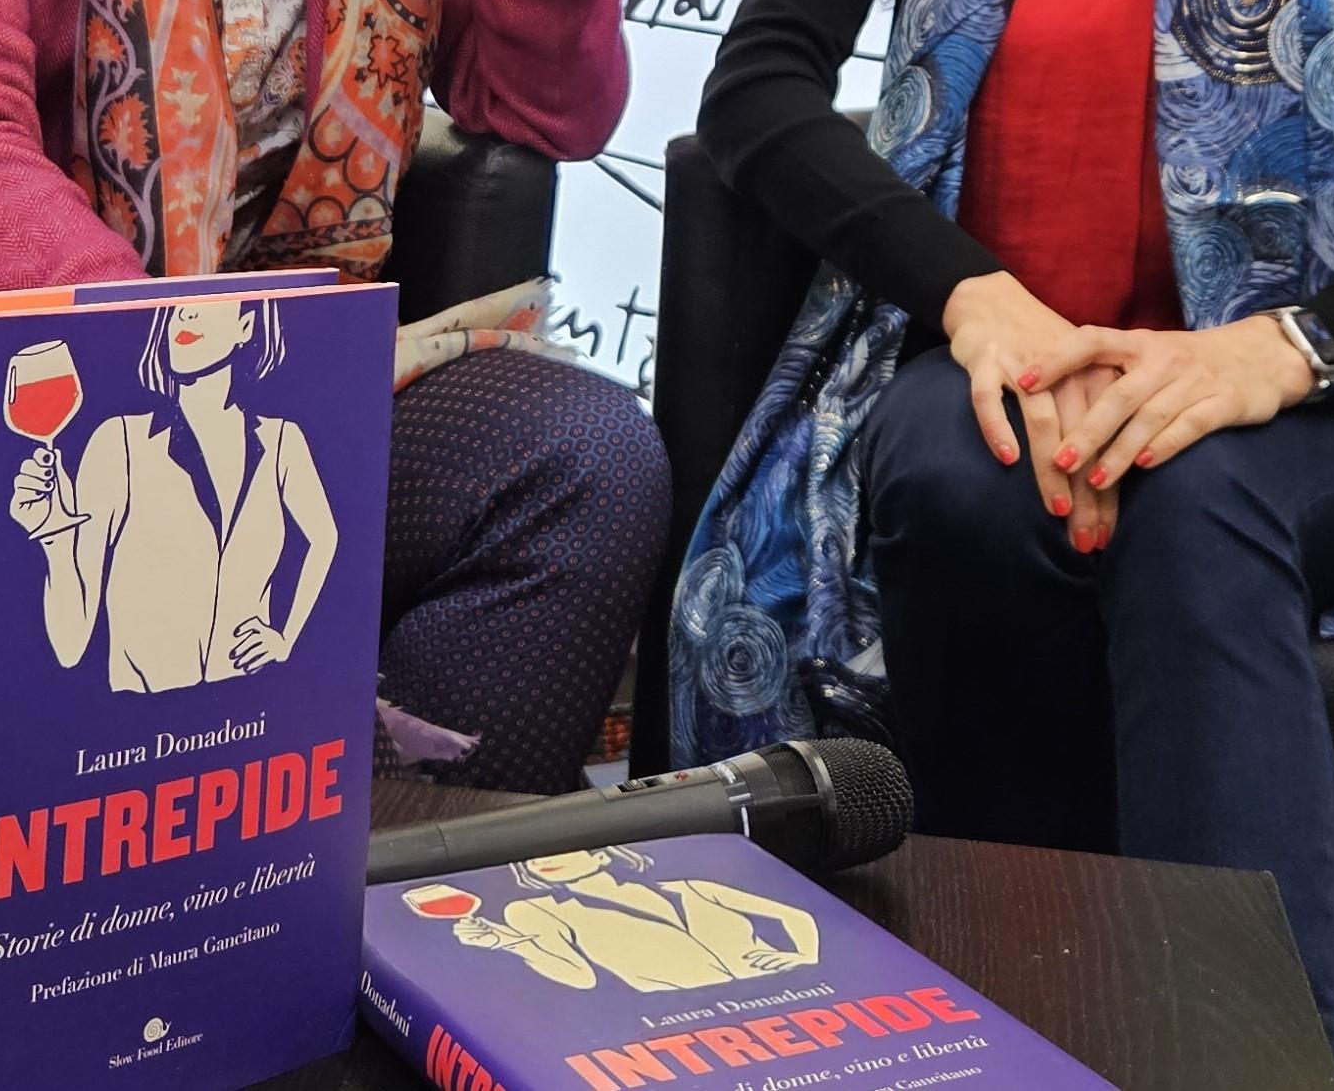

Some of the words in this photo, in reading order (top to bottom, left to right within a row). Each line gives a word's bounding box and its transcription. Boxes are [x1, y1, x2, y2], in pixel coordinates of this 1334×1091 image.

[75, 743, 147, 777] Laura
[154, 711, 267, 759] Donadoni
[69, 914, 95, 945] di
[99, 900, 176, 936] donne,
[182, 882, 229, 914] vino
[233, 880, 247, 898] e
[249, 853, 317, 896] libertà
[29, 964, 123, 1005] Prefazione
[126, 956, 144, 977] di
[148, 944, 200, 973] Maura
[202, 919, 281, 956] Gancitano
[360, 969, 412, 1039] Donadoni
[641, 1005, 716, 1030] Laura
[718, 981, 837, 1017] Donadoni
[108, 1053, 135, 1070] Slow
[137, 1041, 164, 1062] Food
[165, 1032, 204, 1053] Editore
[564, 985, 983, 1091] INTREPIDE
[762, 1062, 844, 1091] donne,
[844, 1053, 893, 1077] vino
[897, 1052, 910, 1064] e
[912, 1032, 990, 1062] libertà
[893, 1064, 984, 1091] Gancitano
